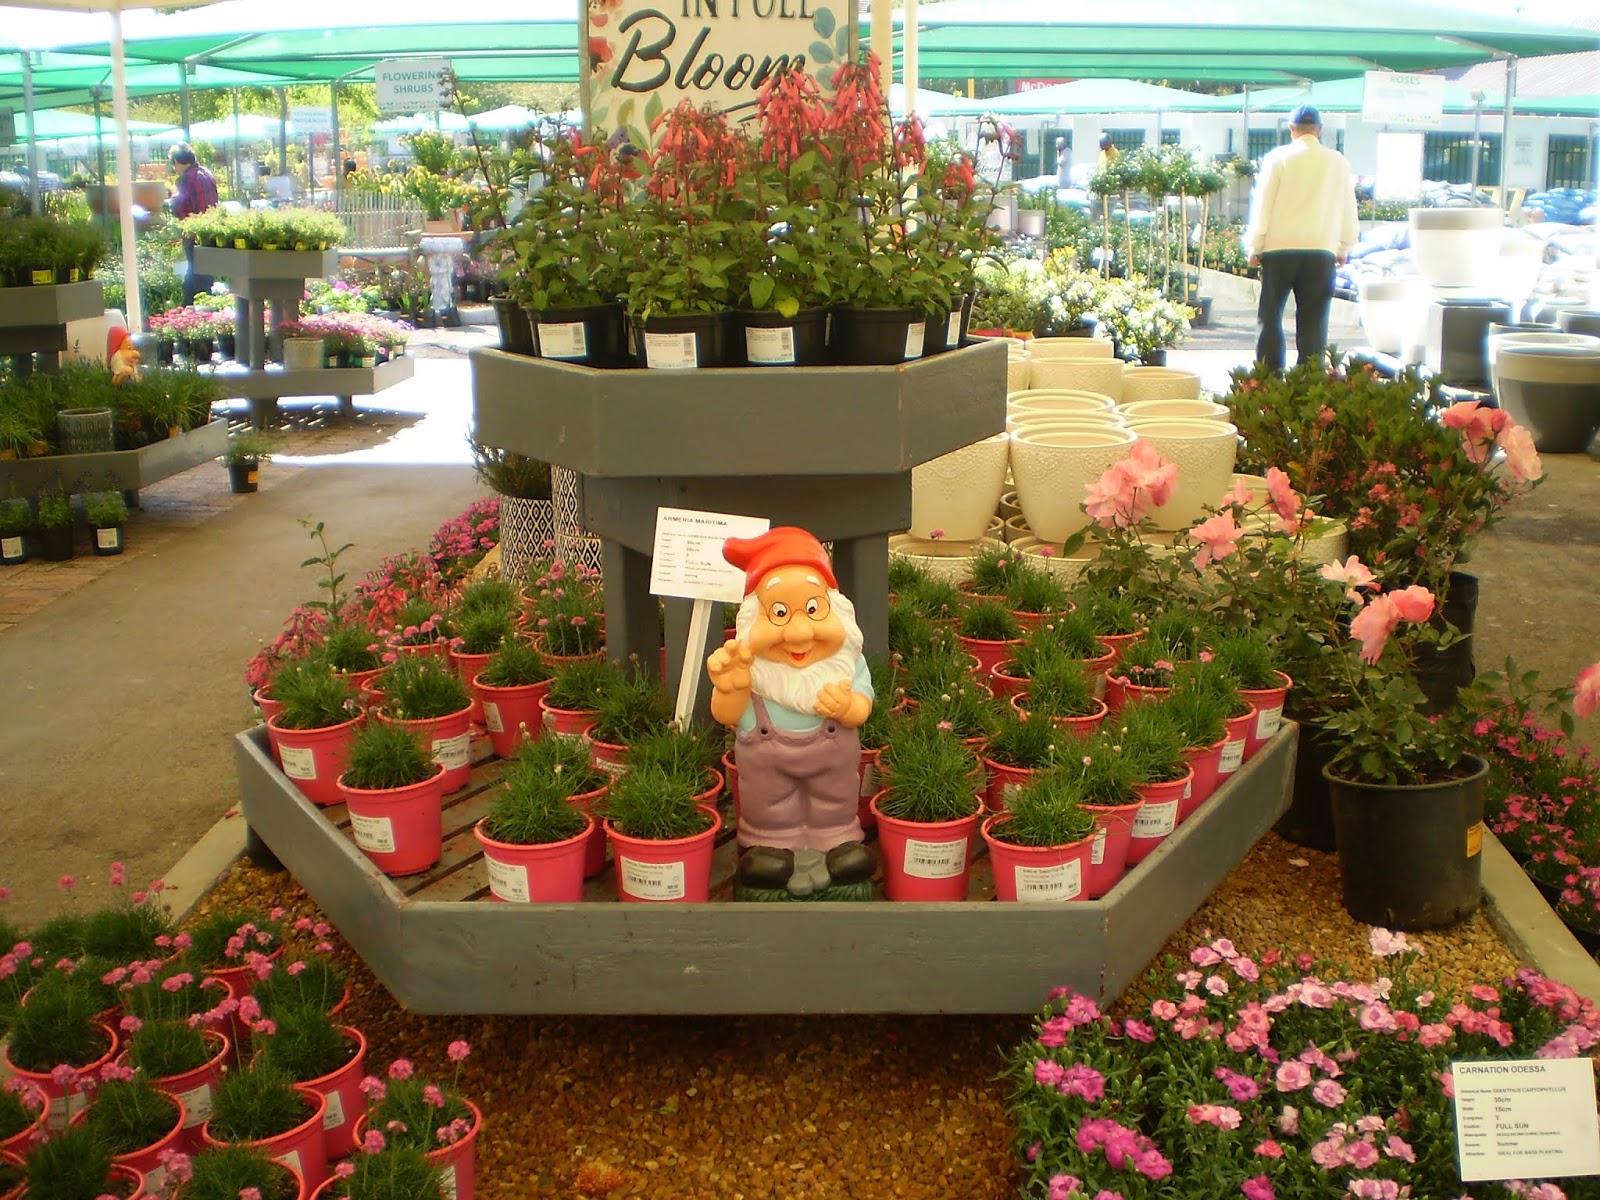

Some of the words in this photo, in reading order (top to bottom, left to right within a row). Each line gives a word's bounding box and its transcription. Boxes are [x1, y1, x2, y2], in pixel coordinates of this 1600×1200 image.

[611, 8, 807, 92] Bloom
[1390, 75, 1421, 85] ROSES
[393, 83, 434, 94] SHRUBS
[663, 515, 693, 523] ARMERIA
[695, 518, 727, 526] MARITIMA
[1459, 1066, 1509, 1074] CARNATION
[1510, 1065, 1546, 1073] ODESSA
